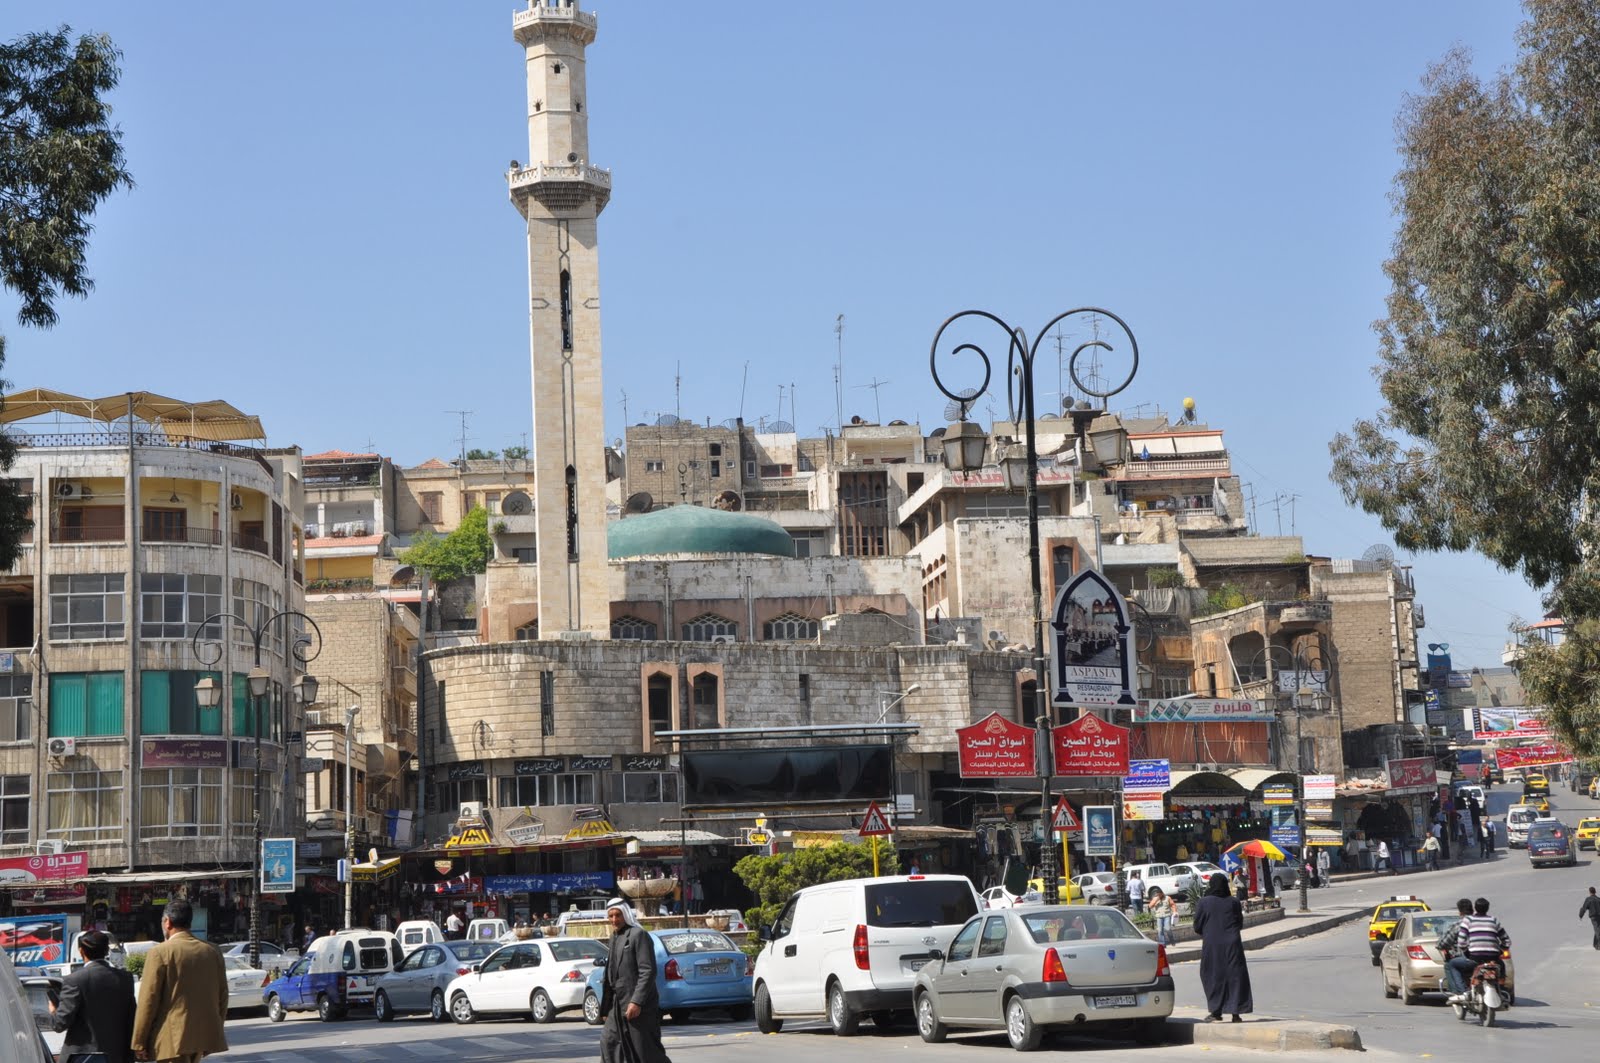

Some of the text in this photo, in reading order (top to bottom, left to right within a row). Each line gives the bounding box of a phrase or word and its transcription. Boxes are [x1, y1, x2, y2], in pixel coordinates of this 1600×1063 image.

[1071, 667, 1117, 678] ASPASIA
[1077, 684, 1112, 692] RESTAURANT
[966, 735, 1026, 749] أسواق الصين
[1062, 735, 1120, 748] أسواق الصين
[974, 750, 1020, 759] بروكار سنتر
[1070, 750, 1115, 758] بروكار سنتر
[47, 855, 82, 868] سدرة
